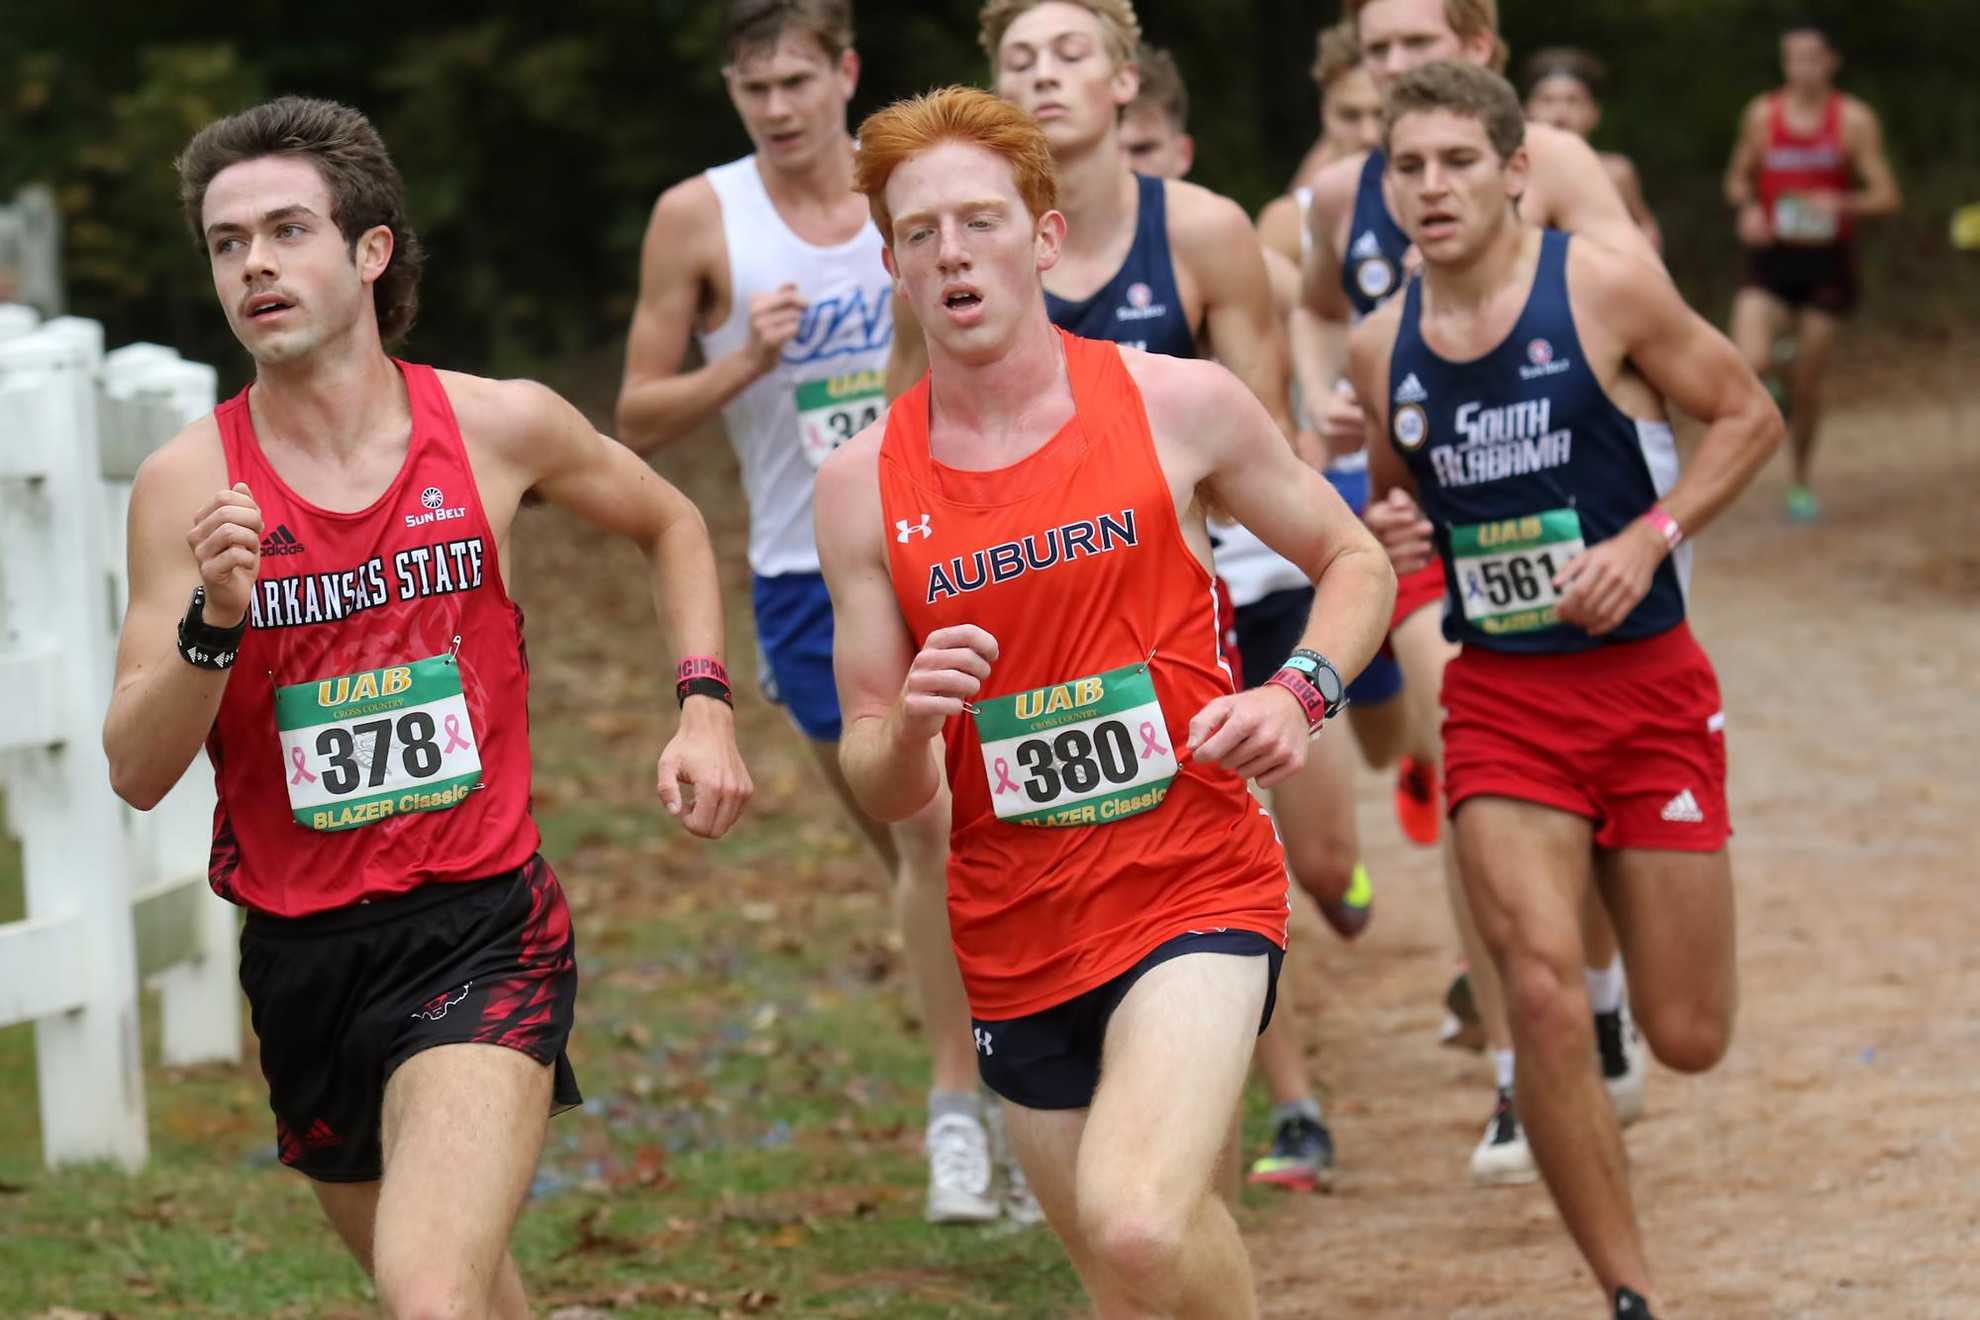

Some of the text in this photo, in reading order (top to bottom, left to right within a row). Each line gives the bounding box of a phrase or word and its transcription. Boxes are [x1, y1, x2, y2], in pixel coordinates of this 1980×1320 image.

[1455, 396, 1551, 447] SOUTH
[1430, 428, 1573, 487] ALABAMA
[926, 508, 1138, 604] AUBURN
[1477, 516, 1543, 547] UAB
[250, 537, 484, 630] ARKANSAS STATE
[1481, 552, 1562, 606] 561
[317, 666, 412, 707] UAB
[333, 698, 404, 719] CROSS COUNTRY
[1015, 677, 1105, 720] UAB
[315, 711, 442, 795] 378
[1016, 720, 1139, 803] 380
[313, 784, 470, 830] BLAZER Classic
[1100, 788, 1168, 819] Classic
